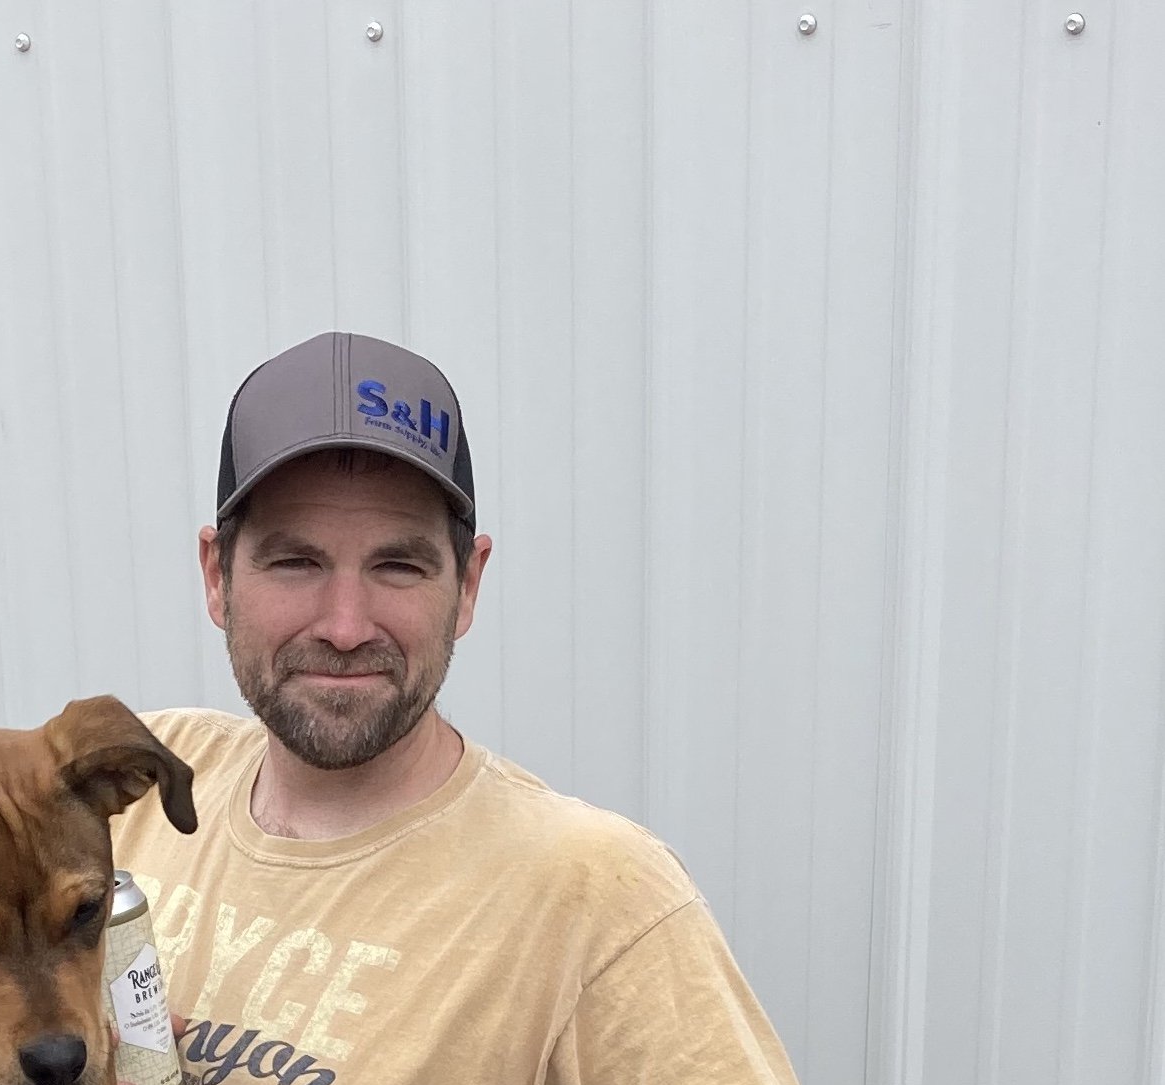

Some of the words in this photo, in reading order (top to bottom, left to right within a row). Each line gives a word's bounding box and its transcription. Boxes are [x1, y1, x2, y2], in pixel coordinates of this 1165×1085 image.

[357, 379, 450, 453] S&H
[134, 872, 402, 1062] RYCE
[135, 981, 161, 1004] BREW
